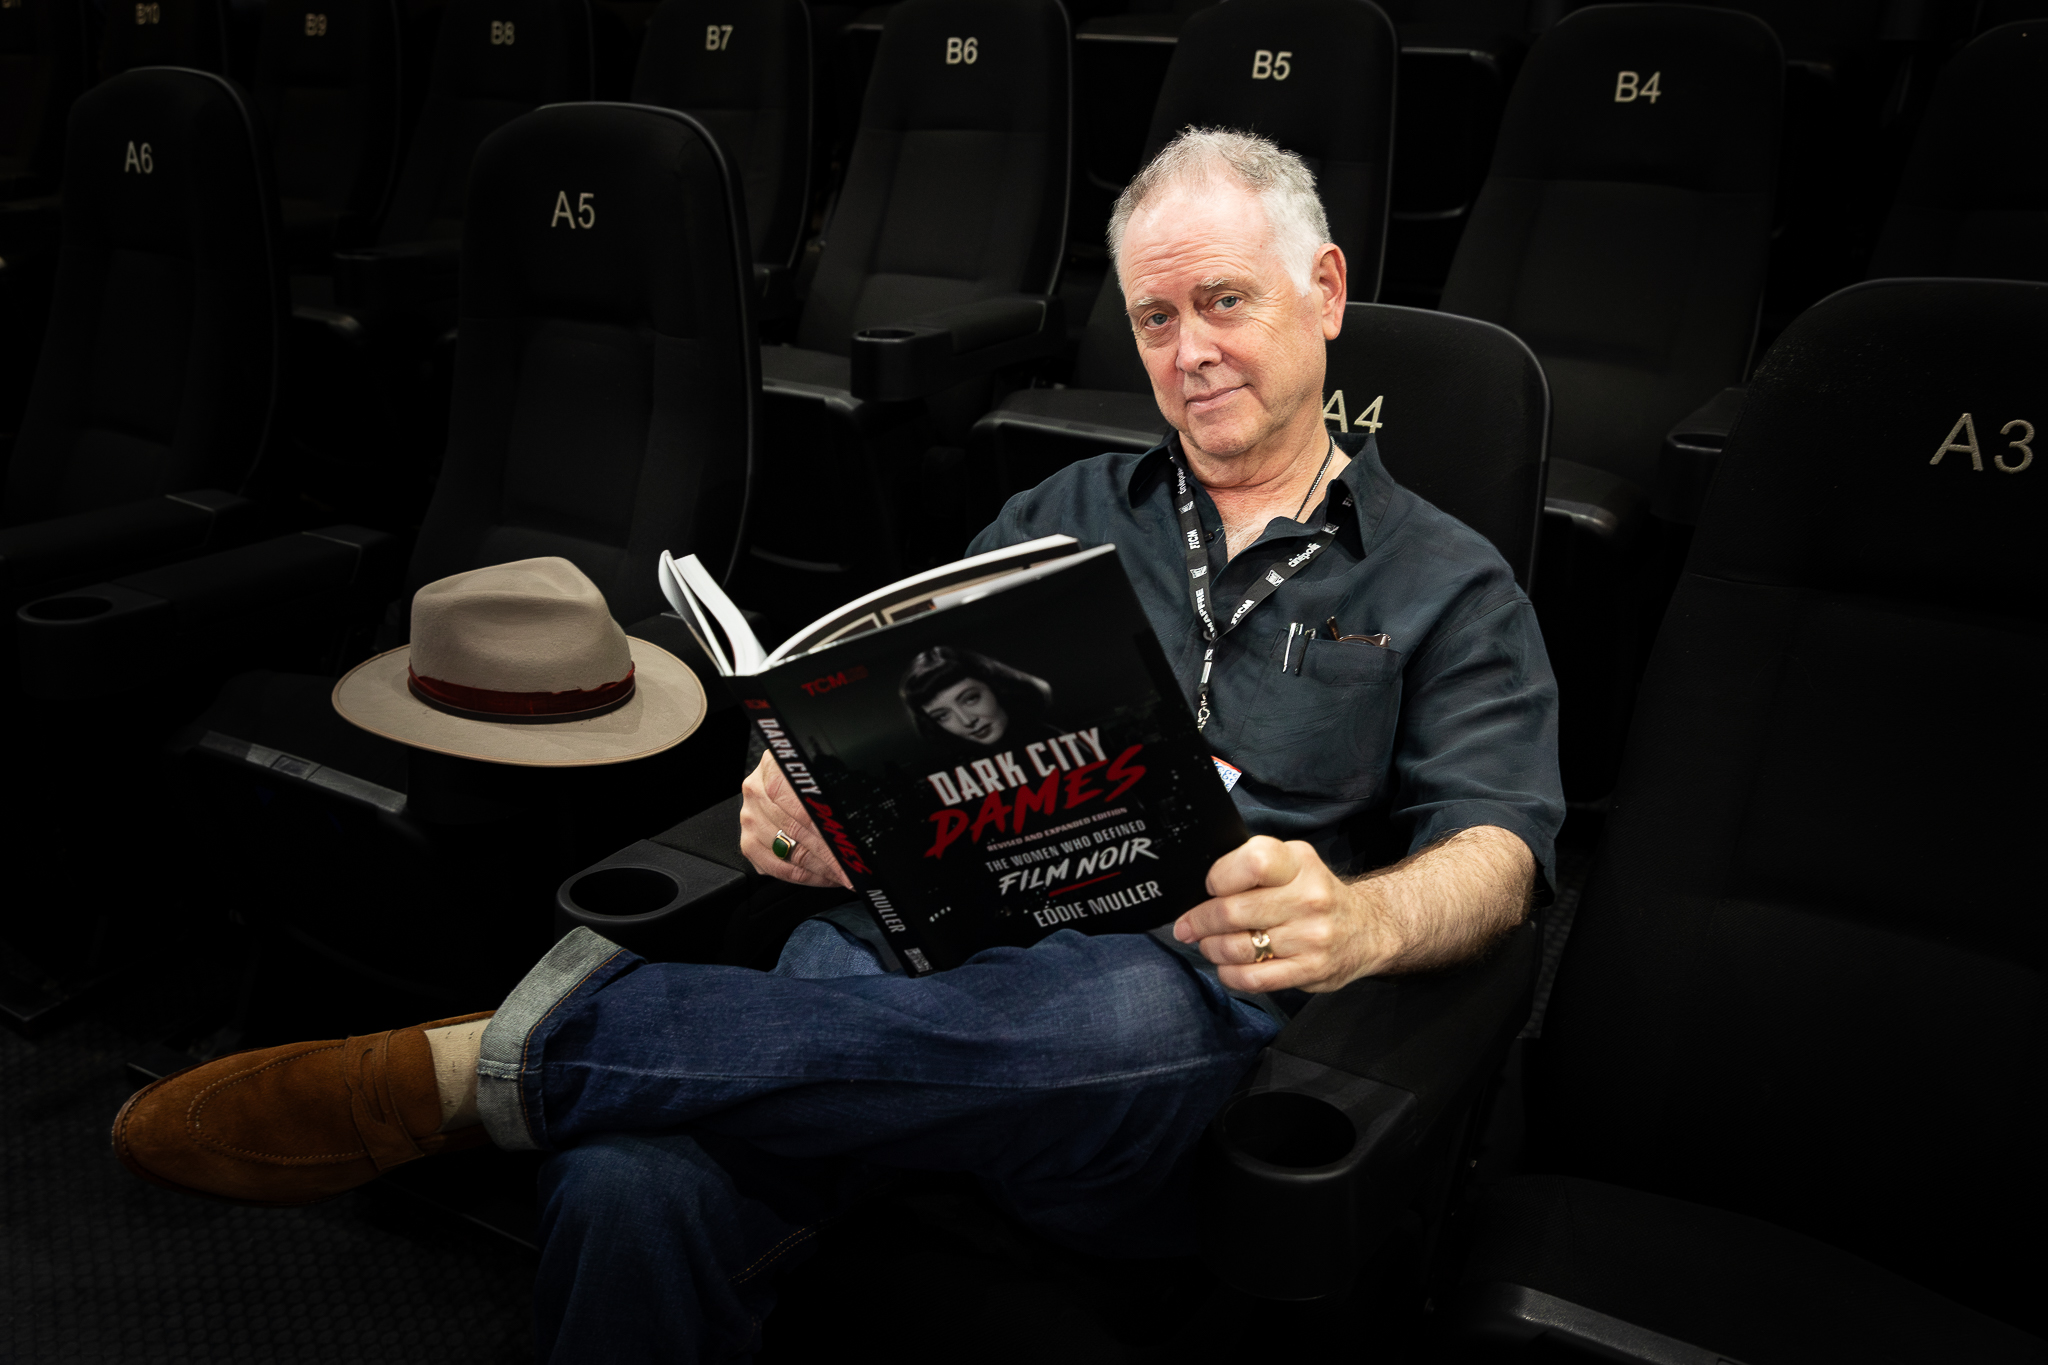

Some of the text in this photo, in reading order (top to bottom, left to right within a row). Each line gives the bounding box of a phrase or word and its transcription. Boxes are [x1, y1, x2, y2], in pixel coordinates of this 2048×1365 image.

[135, 2, 160, 25] B10
[305, 13, 327, 36] B9
[491, 20, 515, 45] B8
[705, 25, 733, 51] B7
[945, 37, 979, 65] B6
[1252, 50, 1292, 81] B5
[1614, 71, 1662, 104] B4
[124, 140, 153, 174] A6
[550, 190, 596, 229] A5
[1323, 389, 1384, 433] A4
[1929, 412, 2035, 475] A3
[1186, 528, 1200, 550] FICM
[1195, 587, 1215, 633] MAPFRE
[801, 671, 849, 697] TCM
[927, 726, 1109, 808] DARK CITY
[757, 717, 796, 760] DARK
[785, 762, 823, 796] CITY
[805, 796, 873, 876] DAMES
[923, 743, 1147, 861] DAMES
[985, 818, 1147, 873] THE WOMEN WHO DEFINED
[986, 806, 1128, 852] REVISED AND EXPANDED EDITION
[998, 836, 1160, 896] FILM NOIR
[866, 887, 907, 935] MULLER
[1032, 879, 1164, 929] EDDIE MULLER
